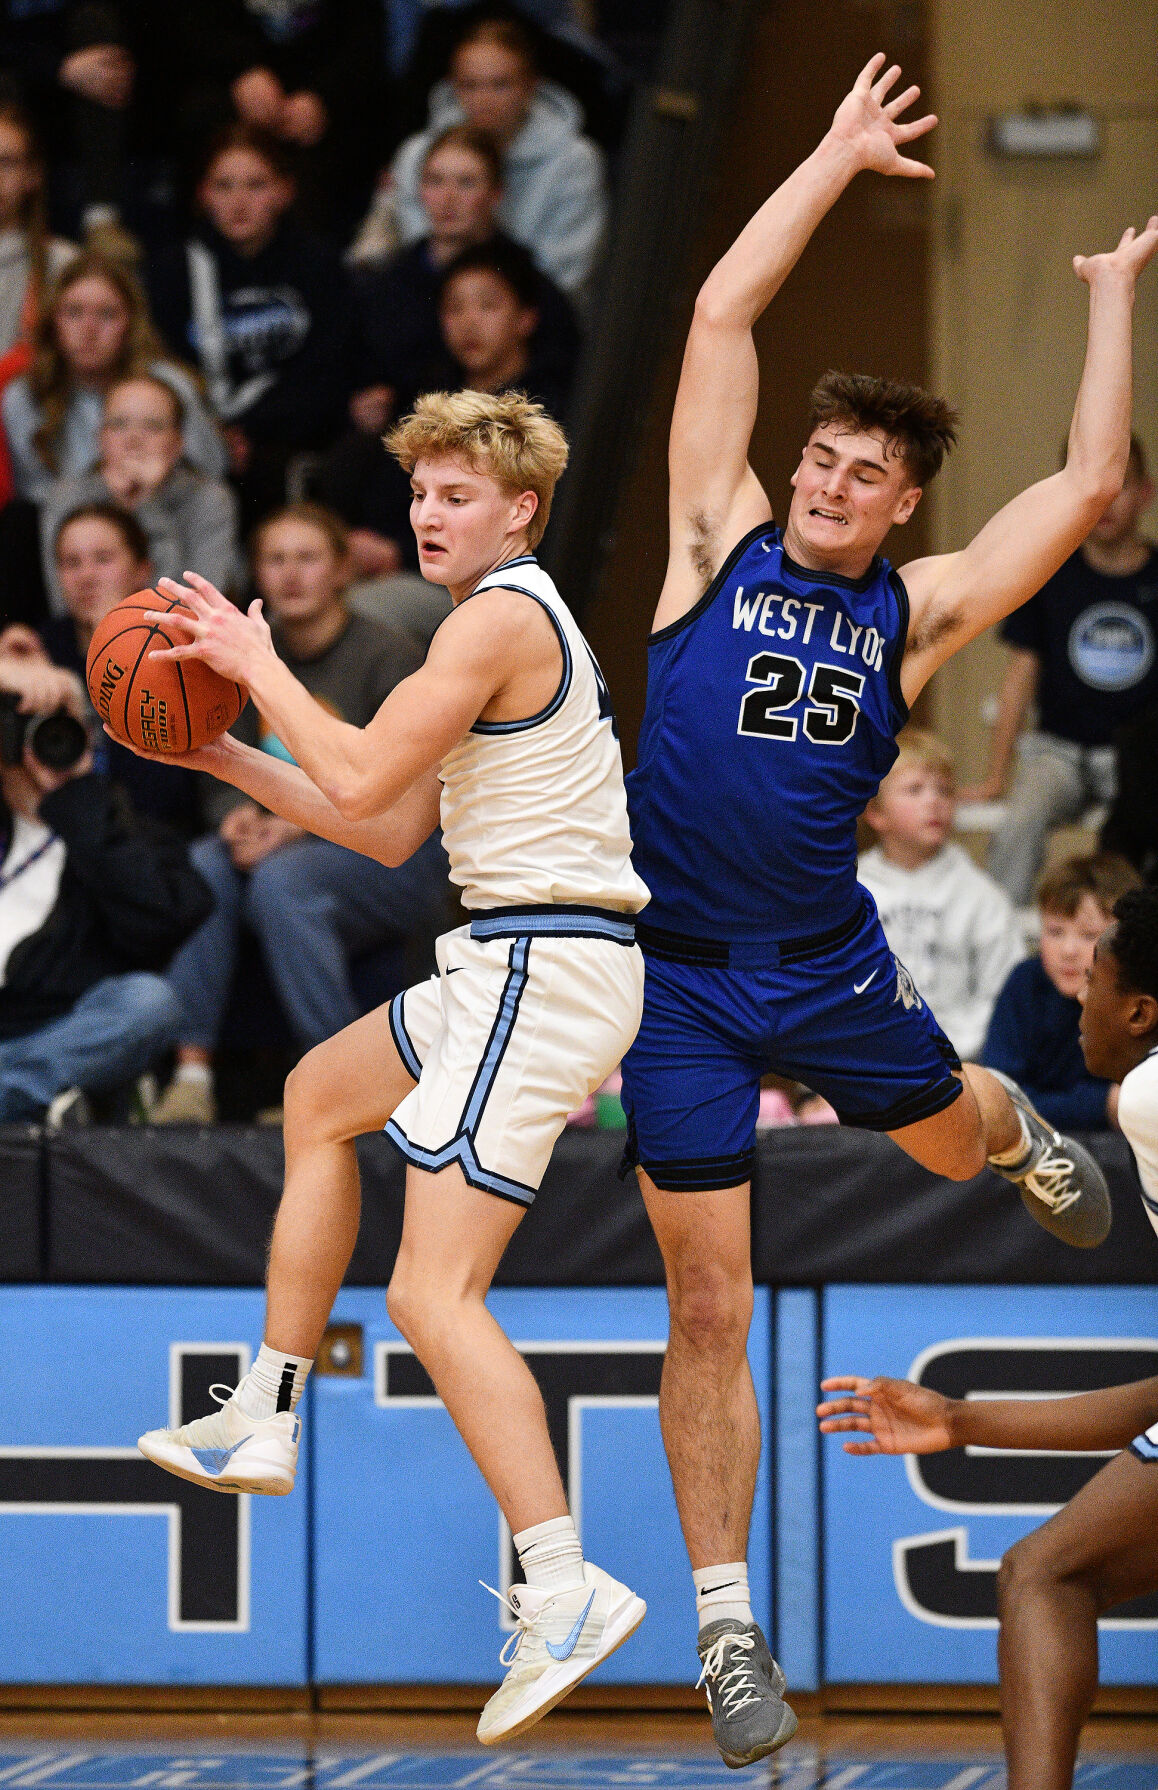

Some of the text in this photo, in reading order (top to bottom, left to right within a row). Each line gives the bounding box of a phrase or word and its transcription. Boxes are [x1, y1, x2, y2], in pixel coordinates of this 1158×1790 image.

[732, 585, 824, 645] WEST
[99, 658, 125, 726] LDING
[736, 650, 866, 746] 25
[158, 699, 171, 750] F1000
